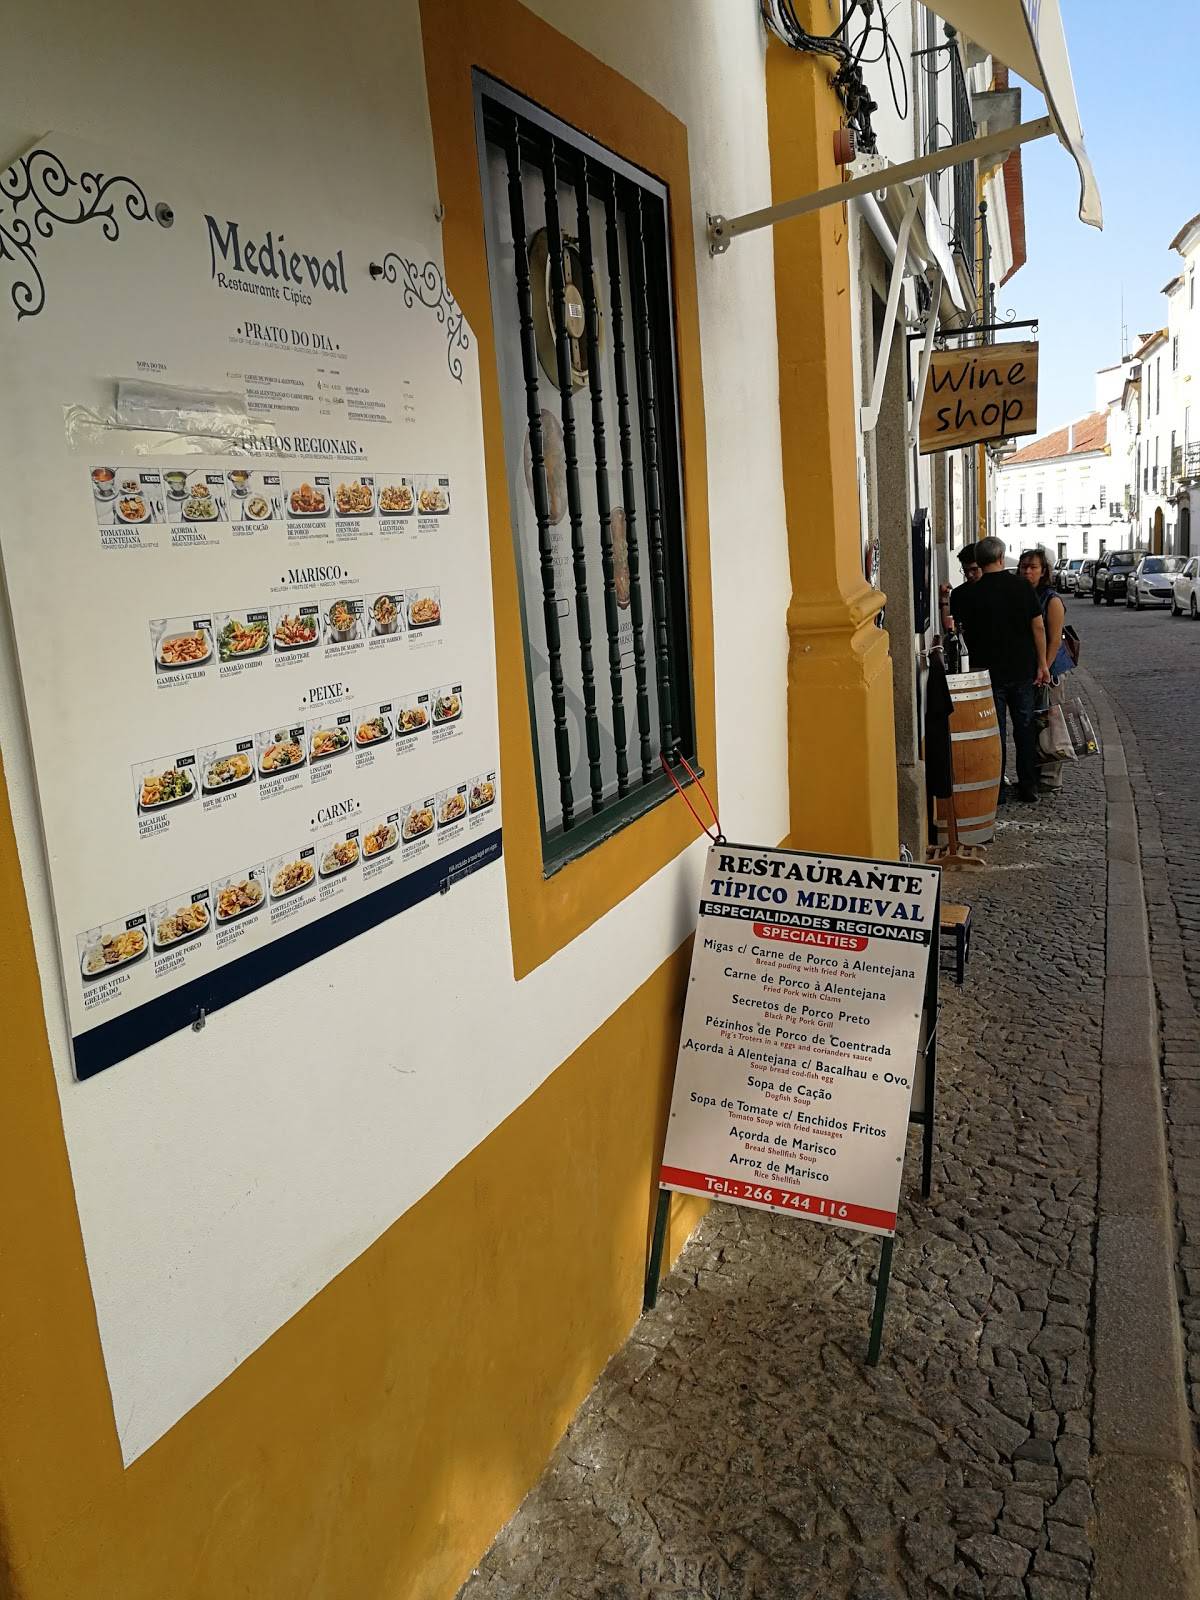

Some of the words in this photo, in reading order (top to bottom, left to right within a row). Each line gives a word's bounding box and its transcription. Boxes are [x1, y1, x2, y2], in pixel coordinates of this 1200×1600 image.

[204, 214, 348, 294] Medieval
[217, 272, 280, 300] Restaurante
[244, 321, 289, 344] PRATO
[290, 329, 310, 347] DO
[311, 333, 334, 351] DIA
[931, 358, 1026, 393] Wine
[935, 399, 1023, 436] shop
[293, 436, 357, 455] REGIONAIS
[287, 565, 342, 584] MARISCO
[309, 682, 344, 703] PEIXE
[317, 798, 355, 823] CARNE
[717, 854, 923, 896] RESTAURANTE
[710, 876, 788, 904] TÍPICO
[795, 890, 925, 923] MEDIEVAL
[703, 903, 833, 929] ESPECIALIDADES
[836, 916, 927, 942] REGIONAIS
[762, 926, 860, 949] SPECIALTIES
[703, 938, 734, 953] Migas
[737, 944, 748, 954] c/
[751, 945, 784, 960] Carne
[788, 951, 802, 962] de
[806, 953, 839, 968] Porco
[842, 958, 849, 969] à
[852, 960, 915, 979] Alentejana
[755, 957, 776, 967] Bread
[803, 965, 819, 974] with
[821, 967, 838, 976] fried
[839, 970, 856, 979] Pork
[723, 967, 757, 981] Carne
[760, 972, 774, 986] de
[778, 975, 810, 990] Porco
[814, 980, 821, 991] à
[823, 982, 886, 1001] Alentejana
[763, 984, 782, 994] Fried
[783, 987, 800, 997] Pork
[801, 992, 817, 1000] with
[732, 993, 779, 1011] Secretos
[783, 1002, 797, 1014] de
[801, 1005, 834, 1020] Porco
[838, 1010, 871, 1026] Preto
[764, 1011, 784, 1021] Black
[785, 1014, 797, 1025] Pig
[798, 1016, 815, 1026] Pork
[817, 1020, 834, 1028] Grill
[757, 1023, 771, 1039] de
[775, 1027, 807, 1042] Porco
[811, 1033, 826, 1045] de
[829, 1034, 892, 1056] Coentrada
[780, 1042, 796, 1050] eggs
[798, 1044, 811, 1052] and
[812, 1047, 851, 1058] corianders
[852, 1054, 873, 1062] sauce
[684, 1038, 724, 1055] Açorda
[727, 1045, 734, 1057] à
[736, 1047, 797, 1067] Alentejana
[801, 1059, 812, 1070] c/
[815, 1060, 867, 1080] Bacalhau
[871, 1073, 879, 1081] e
[883, 1072, 908, 1088] Ovo
[750, 1061, 768, 1073] Soup
[769, 1064, 790, 1075] bread
[791, 1070, 819, 1080] cod-fish
[821, 1075, 834, 1084] egg
[747, 1075, 774, 1093] Sopa
[778, 1081, 793, 1097] de
[797, 1084, 832, 1101] Cação
[764, 1090, 791, 1102] Dogfish
[793, 1096, 811, 1107] Soup
[690, 1091, 717, 1107] Sopa
[720, 1097, 734, 1113] de
[736, 1100, 779, 1118] Tomate
[782, 1110, 793, 1120] c/
[797, 1111, 848, 1131] Enchidos
[852, 1121, 887, 1138] Fritos
[728, 1110, 754, 1122] Tomato
[756, 1116, 774, 1128] Soup
[775, 1121, 792, 1129] with
[793, 1123, 811, 1133] fried
[729, 1126, 770, 1144] Açorda
[773, 1135, 788, 1147] de
[792, 1137, 837, 1156] Marisco
[744, 1142, 766, 1153] Bread
[767, 1147, 797, 1159] Shellfish
[799, 1152, 817, 1164] Soup
[729, 1153, 762, 1169] Arroz
[766, 1160, 780, 1173] de
[784, 1163, 829, 1182] Marisco
[754, 1169, 769, 1180] Rice
[771, 1173, 801, 1186] Shellfish
[704, 1176, 739, 1195] Tel.:
[743, 1185, 773, 1202] 266
[781, 1192, 810, 1210] 744
[819, 1200, 848, 1218] 116
